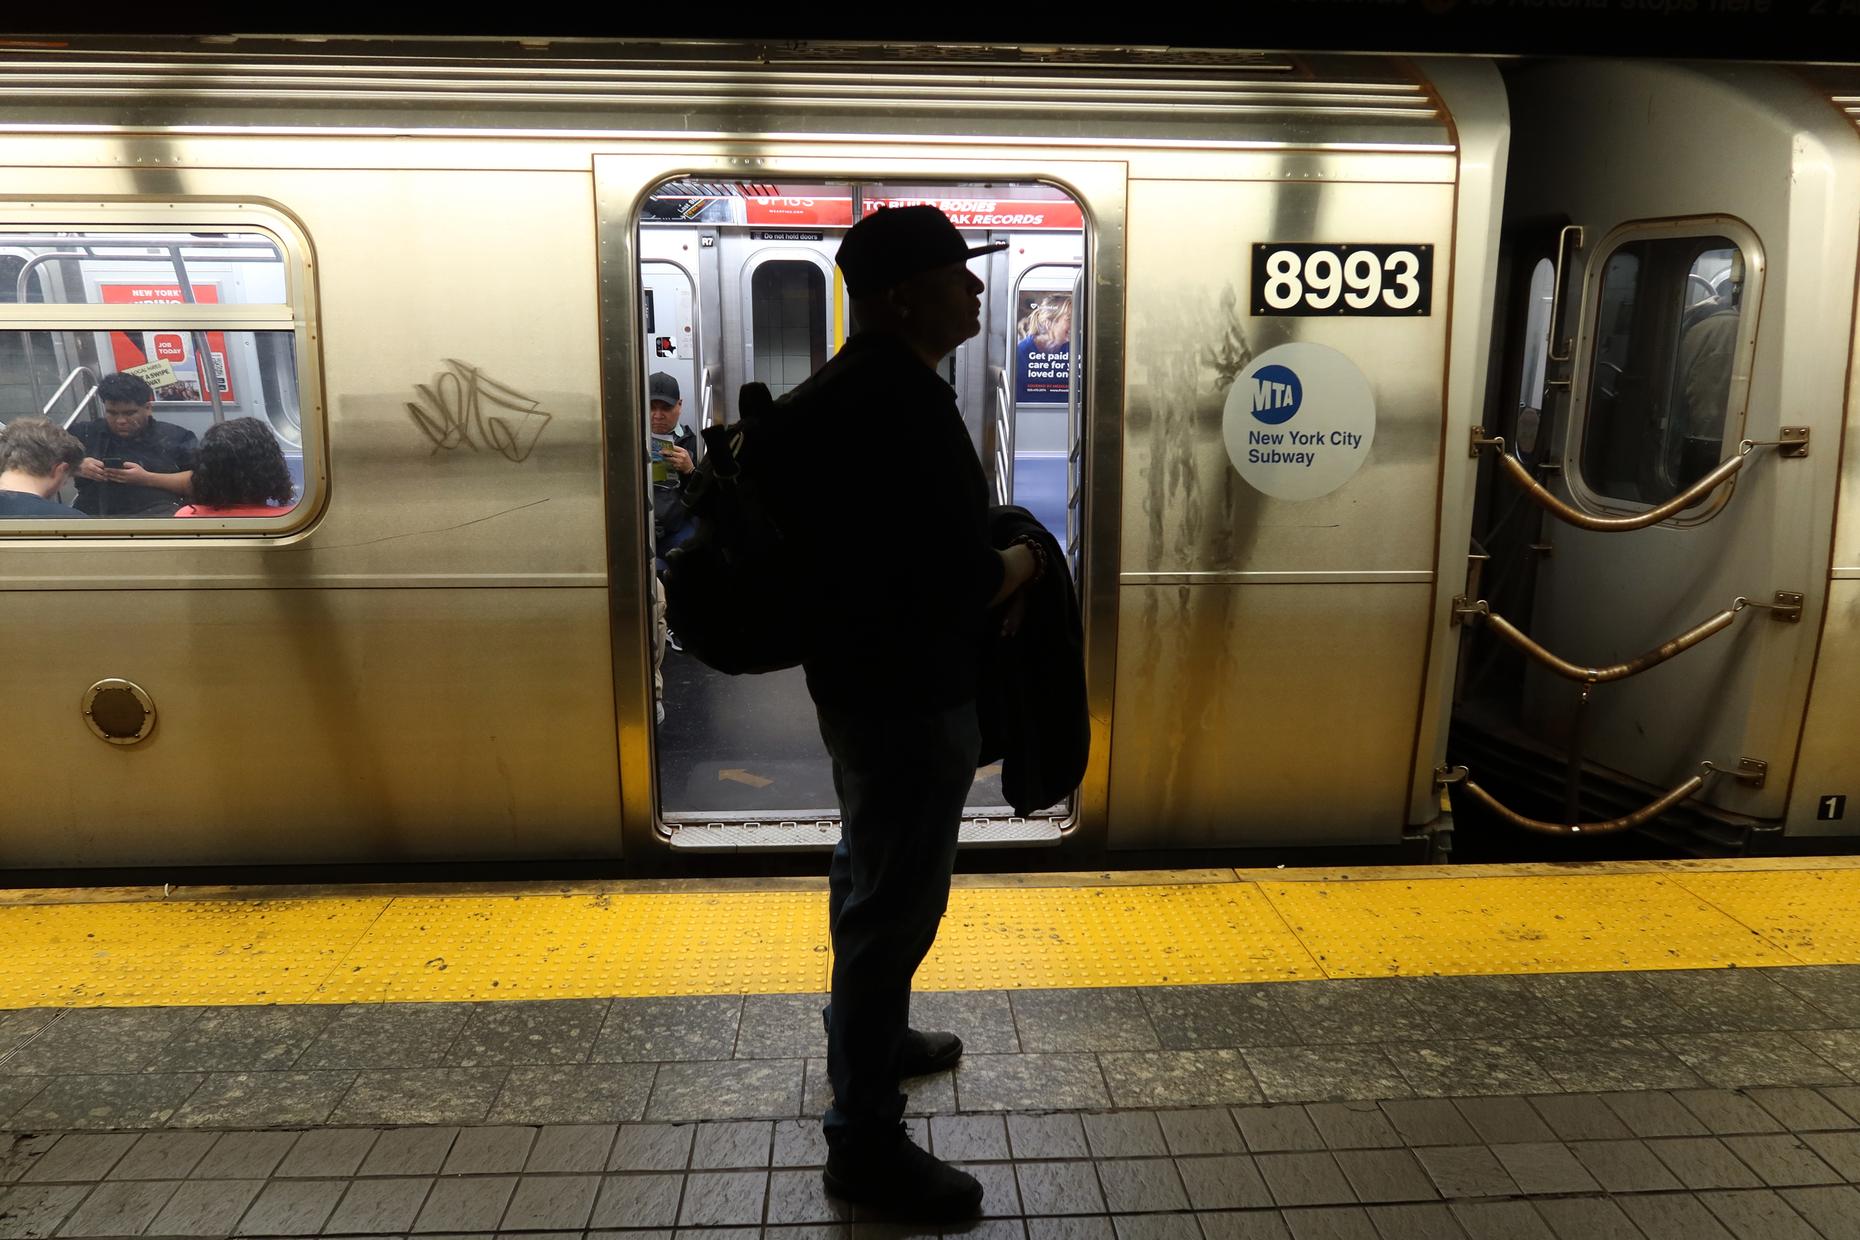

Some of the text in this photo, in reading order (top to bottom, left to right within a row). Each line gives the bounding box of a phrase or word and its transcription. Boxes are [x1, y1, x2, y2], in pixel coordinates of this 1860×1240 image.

[939, 200, 996, 212] BODIES
[972, 214, 1043, 225] RECORDS
[702, 237, 713, 246] R7
[1264, 250, 1420, 309] 8993
[132, 289, 182, 297] NEW YORK'
[1028, 352, 1069, 362] Get paid
[1051, 361, 1065, 369] for
[1028, 369, 1054, 378] loved
[1250, 378, 1294, 412] MTA
[1249, 431, 1362, 449] New York City
[1249, 449, 1315, 467] Subway
[1825, 797, 1837, 818] 1
